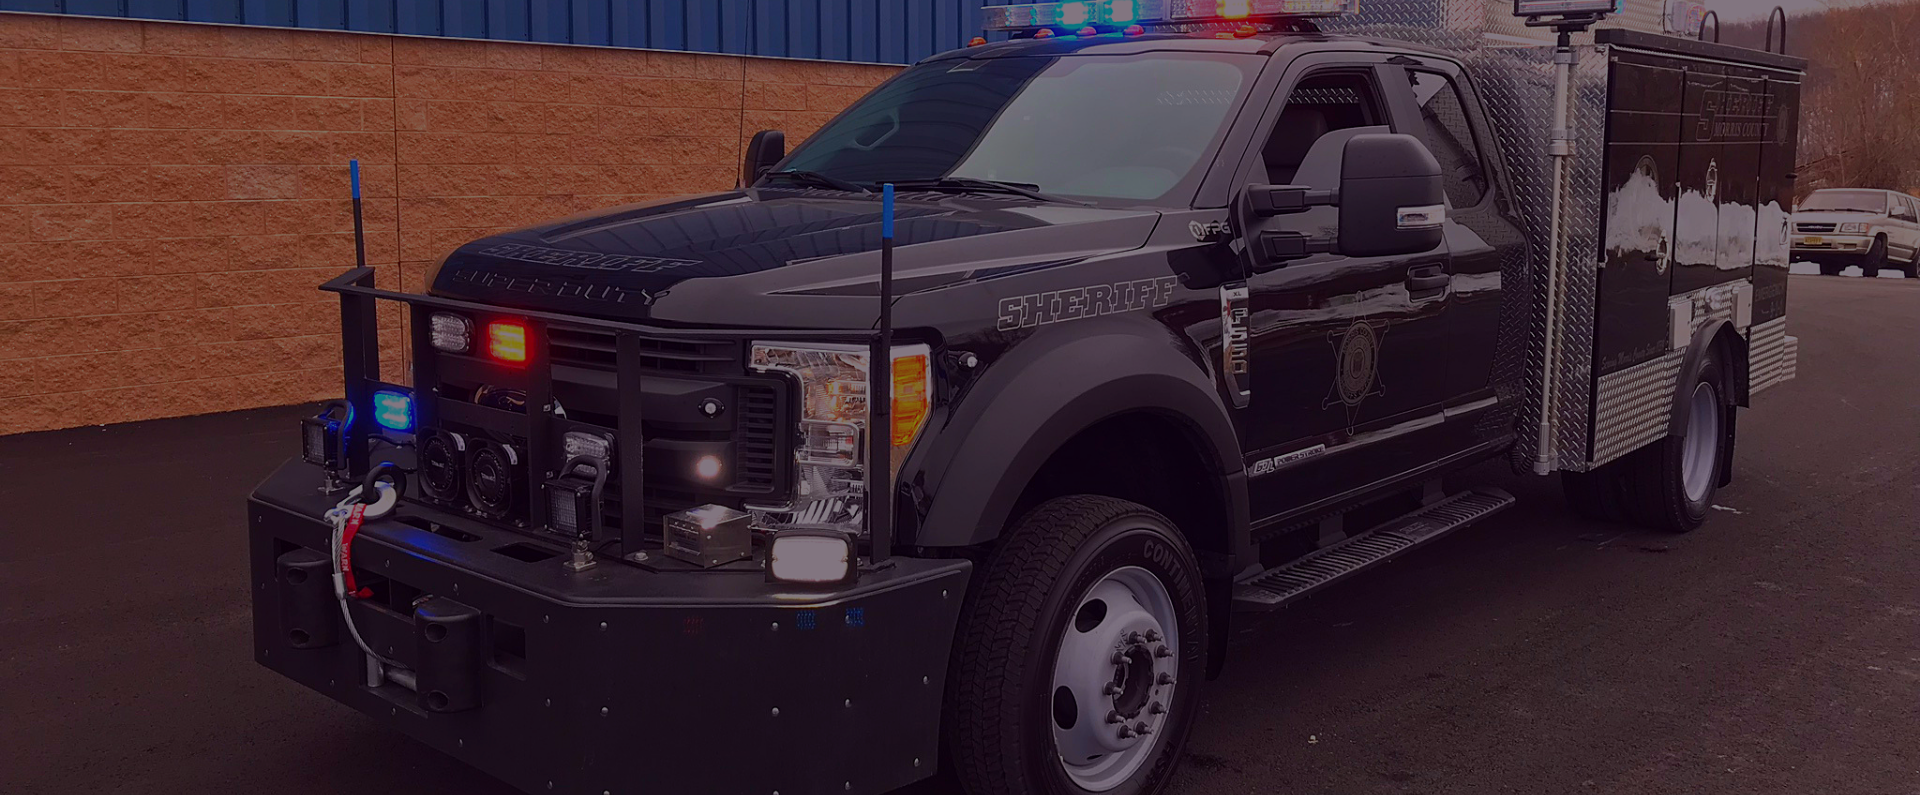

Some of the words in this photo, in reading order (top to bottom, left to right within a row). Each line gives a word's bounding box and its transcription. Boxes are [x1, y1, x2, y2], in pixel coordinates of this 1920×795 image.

[1714, 122, 1741, 137] MORRIS
[1204, 222, 1231, 236] FPG
[478, 243, 703, 273] SHERIFF
[453, 270, 551, 295] SUPER
[556, 281, 670, 306] DUTY
[996, 275, 1178, 332] SHERIFF
[1143, 539, 1200, 662] CONTINENTAL
